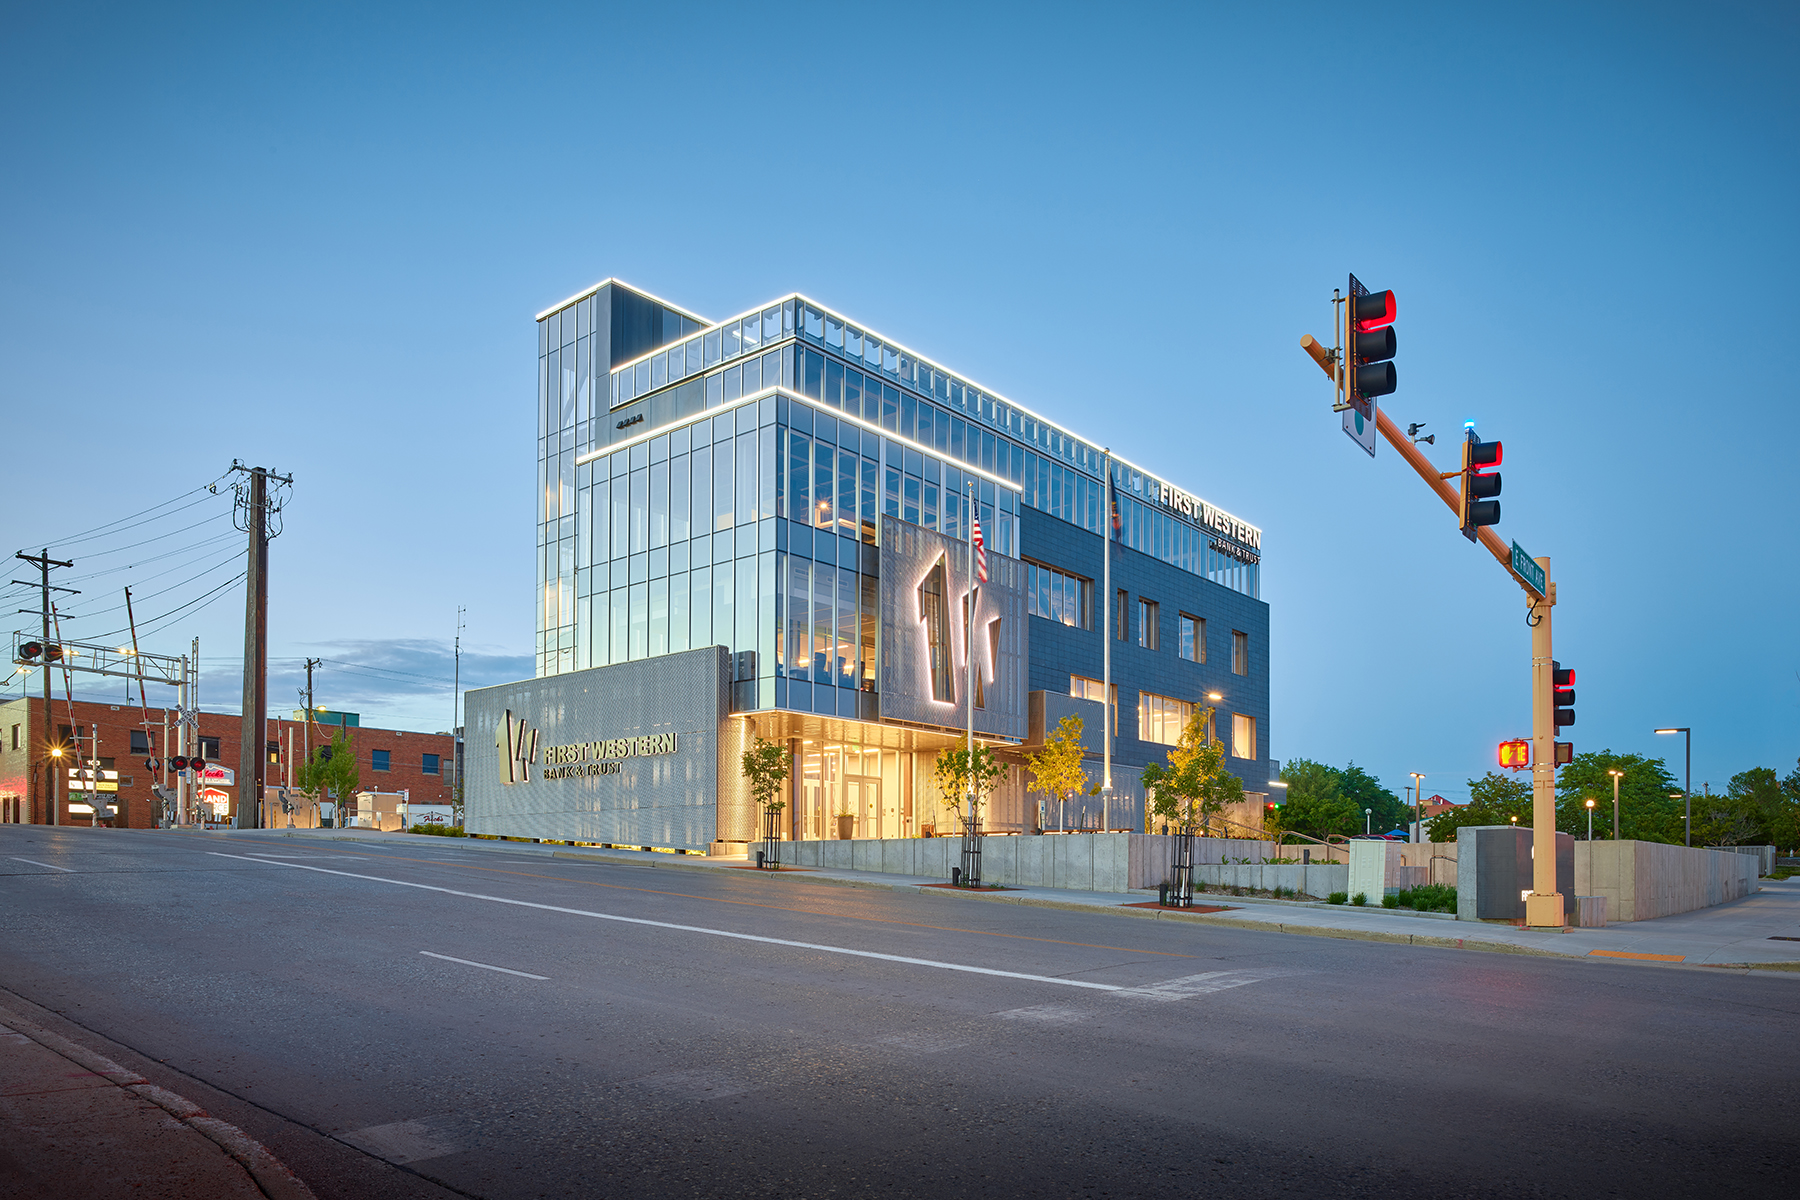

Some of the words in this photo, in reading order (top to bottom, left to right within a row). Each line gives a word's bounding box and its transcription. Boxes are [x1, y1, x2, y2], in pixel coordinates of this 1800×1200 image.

[1160, 482, 1200, 519] FIRST
[1202, 503, 1261, 550] WESTERN
[1217, 537, 1235, 554] BANK
[1241, 549, 1261, 565] TRUST
[1515, 549, 1519, 566] E
[1520, 554, 1534, 580] FRONT
[543, 743, 590, 765] FIRST
[590, 732, 678, 760] WESTERN
[543, 766, 574, 780] BANK
[575, 765, 585, 777] &
[586, 762, 623, 776] TRUST
